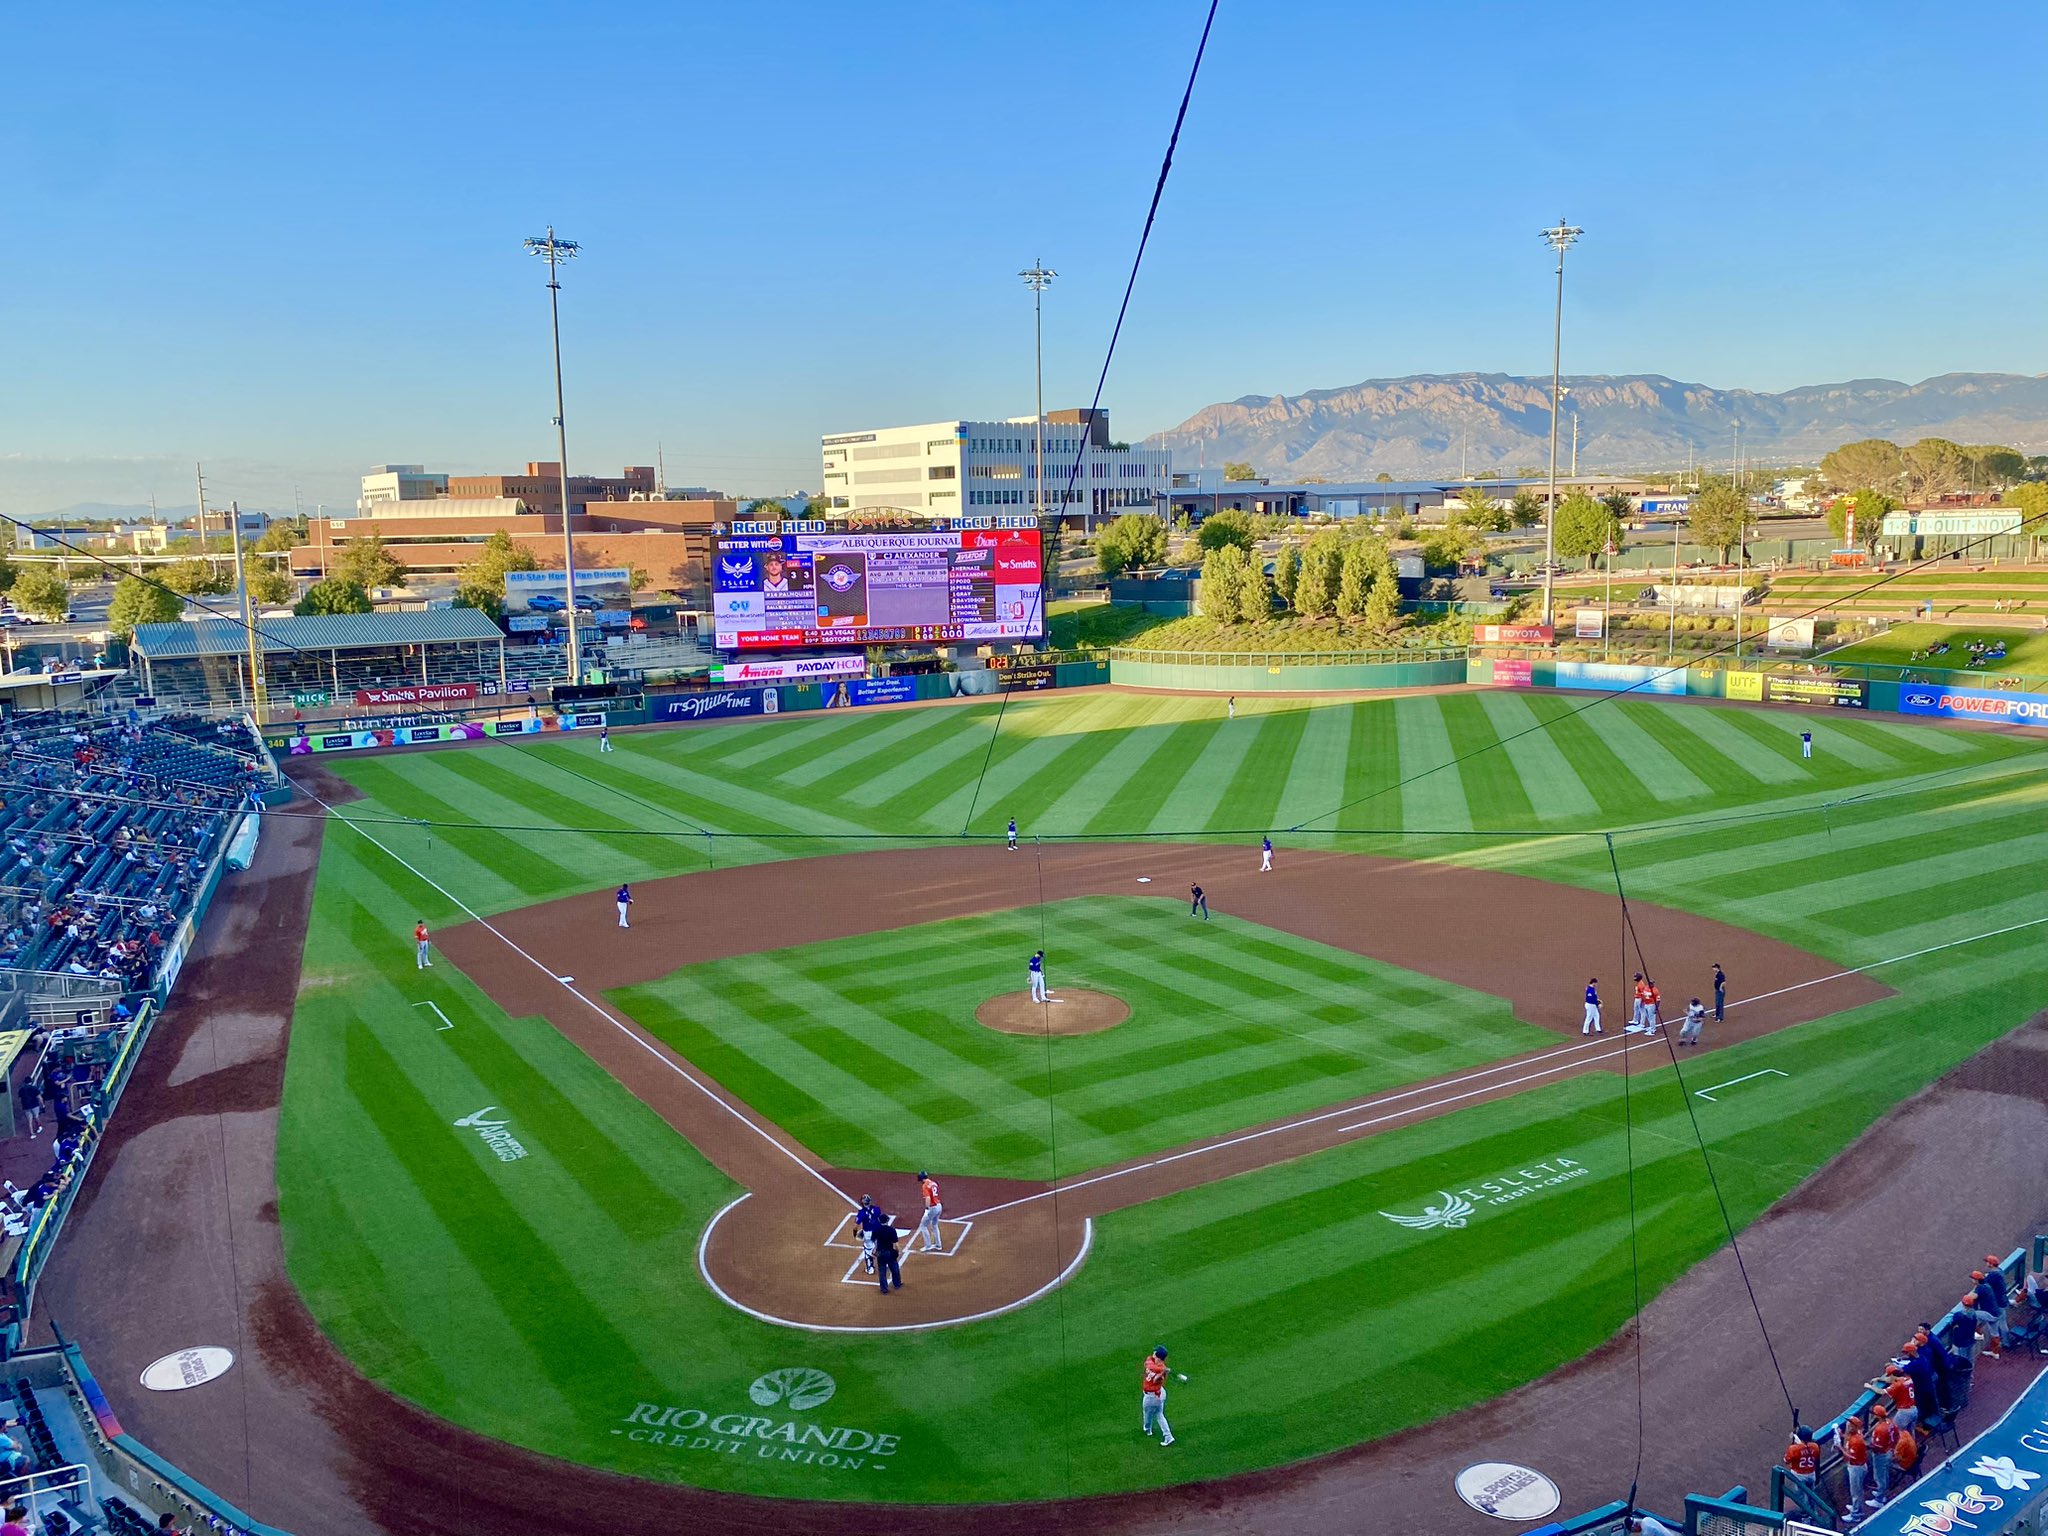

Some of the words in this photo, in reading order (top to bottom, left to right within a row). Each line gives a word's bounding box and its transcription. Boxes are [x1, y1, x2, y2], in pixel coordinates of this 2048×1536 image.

[731, 520, 777, 534] RGCU
[780, 520, 826, 534] FIELD
[950, 517, 991, 530] RGCU
[996, 516, 1038, 529] FIELD
[842, 538, 916, 548] ALBUQUERQUE
[917, 537, 960, 547] JOURNAL
[974, 533, 998, 546] Dion's
[1010, 559, 1036, 569] Smith's
[594, 570, 626, 579] Drivers
[739, 665, 783, 678] Amana
[797, 662, 836, 672] PAYDAY
[836, 658, 862, 669] HCM
[1730, 676, 1756, 687] WTF
[382, 692, 416, 702] Smith's
[419, 686, 466, 698] Pavilion
[483, 687, 496, 695] 19
[298, 694, 326, 702] NICK
[668, 702, 687, 713] IT'S
[686, 692, 734, 717] Miller
[726, 697, 751, 708] TIME
[1911, 696, 1930, 705] Ford
[1939, 694, 2048, 719] POWERFORD
[268, 740, 284, 748] 340
[1459, 1157, 1579, 1201] ISLETA
[1488, 1186, 1535, 1206] resort
[1544, 1168, 1589, 1186] casino
[623, 1402, 708, 1429] RIO
[710, 1414, 901, 1456] GRANDE
[628, 1429, 747, 1454] CREDIT
[758, 1444, 864, 1470] UNION
[1799, 1457, 1815, 1468] 25
